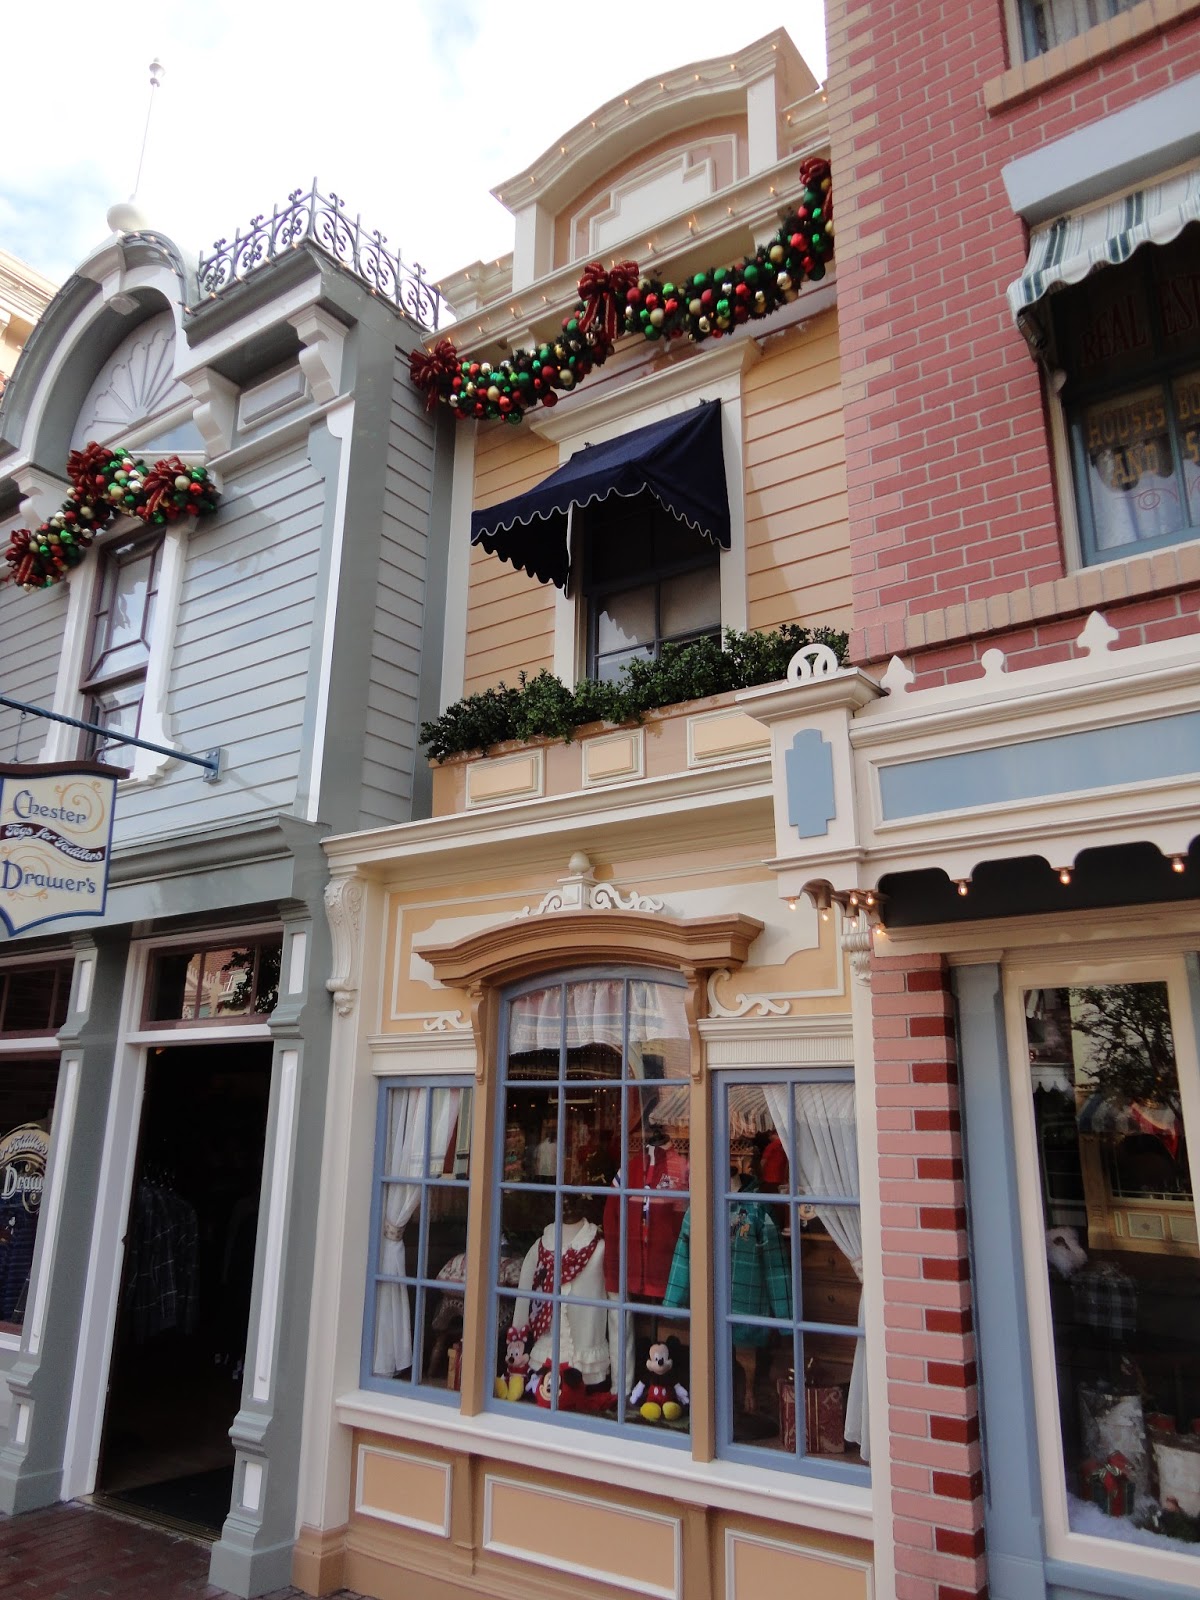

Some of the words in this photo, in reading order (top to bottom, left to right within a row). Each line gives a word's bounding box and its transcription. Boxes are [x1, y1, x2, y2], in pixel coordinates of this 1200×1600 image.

[1080, 294, 1149, 367] REAL
[1110, 441, 1159, 488] AND
[13, 790, 87, 824] Chester
[5, 823, 34, 840] Togs
[31, 827, 57, 842] for
[54, 837, 103, 862] Toddlers
[1, 859, 96, 894] Drawer's
